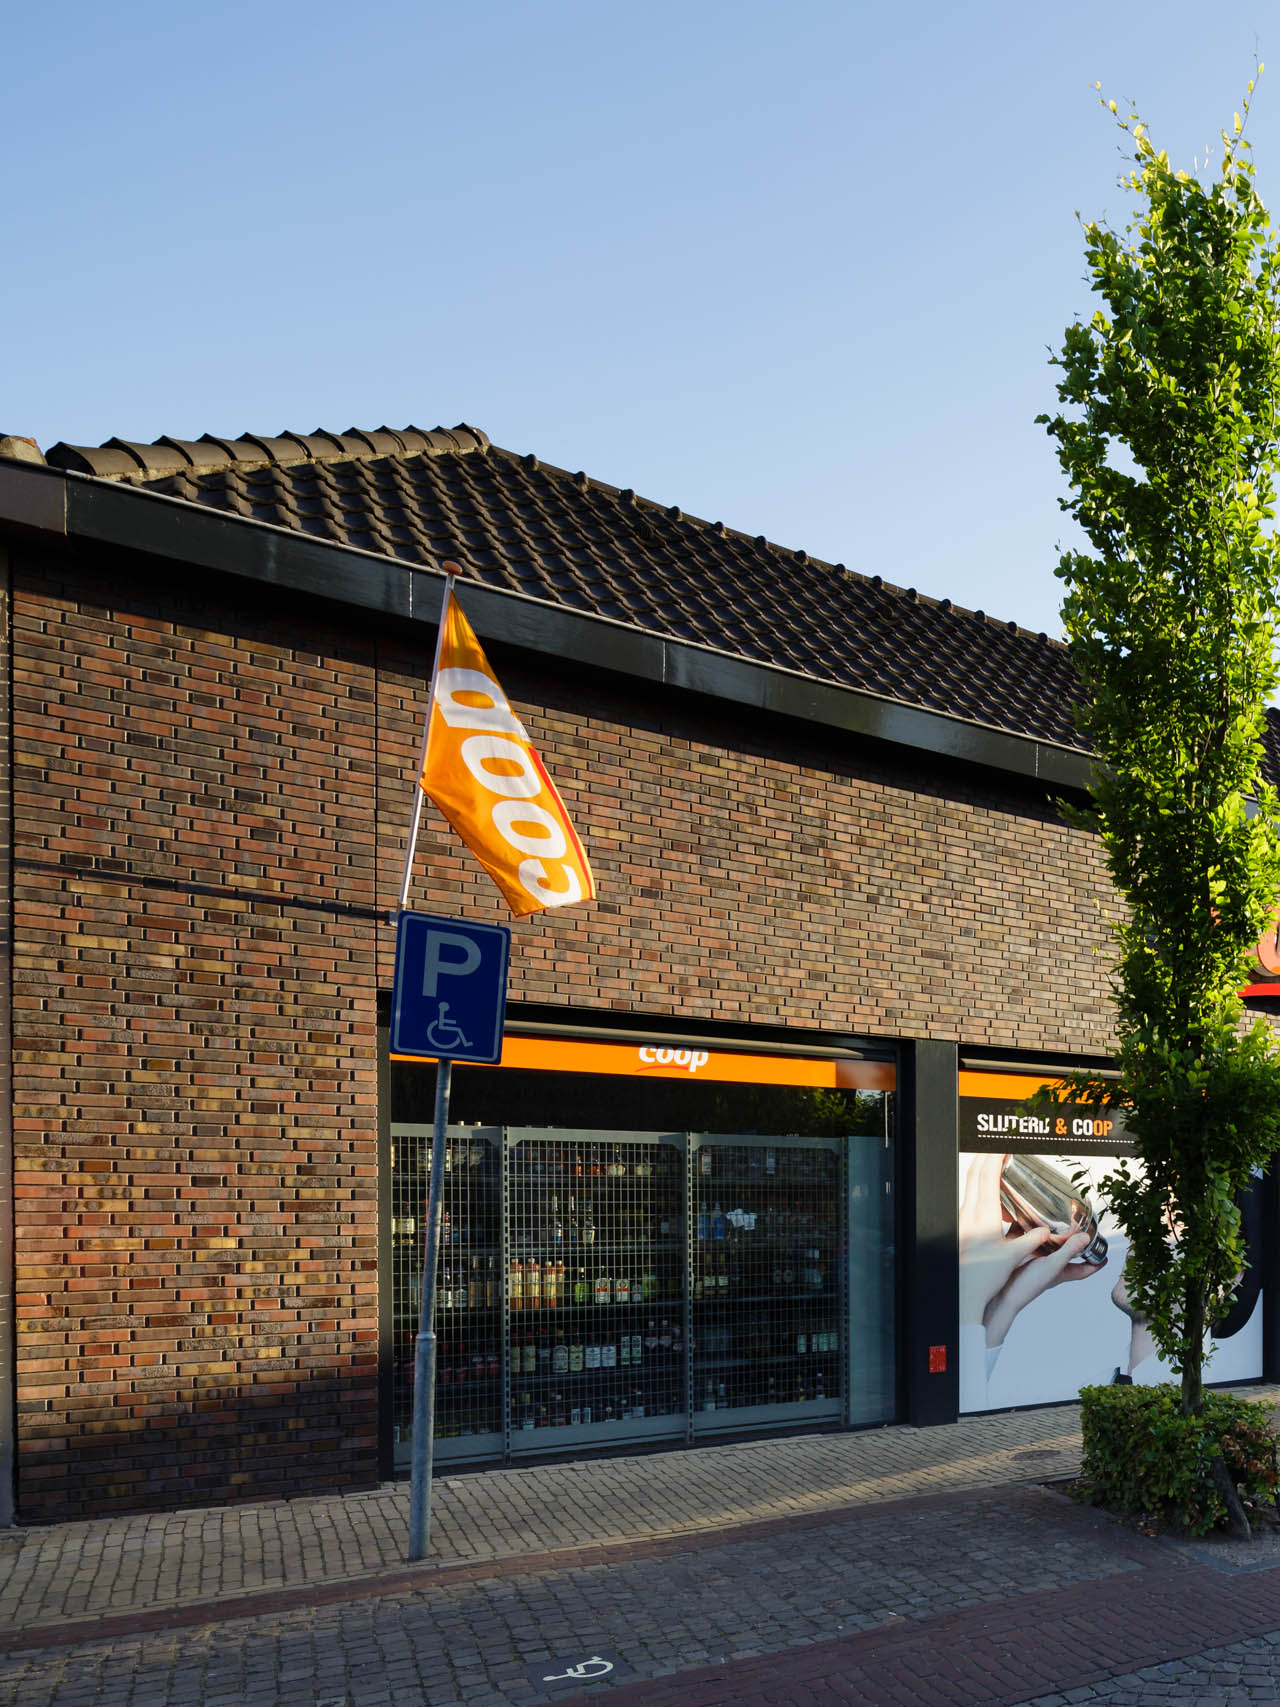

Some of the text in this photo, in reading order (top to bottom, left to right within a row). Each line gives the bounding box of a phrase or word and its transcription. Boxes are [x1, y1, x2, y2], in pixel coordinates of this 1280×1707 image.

[434, 666, 583, 909] coop
[421, 929, 482, 998] P
[638, 1044, 710, 1073] coop
[1055, 1117, 1068, 1135] &
[1072, 1118, 1113, 1137] COOP
